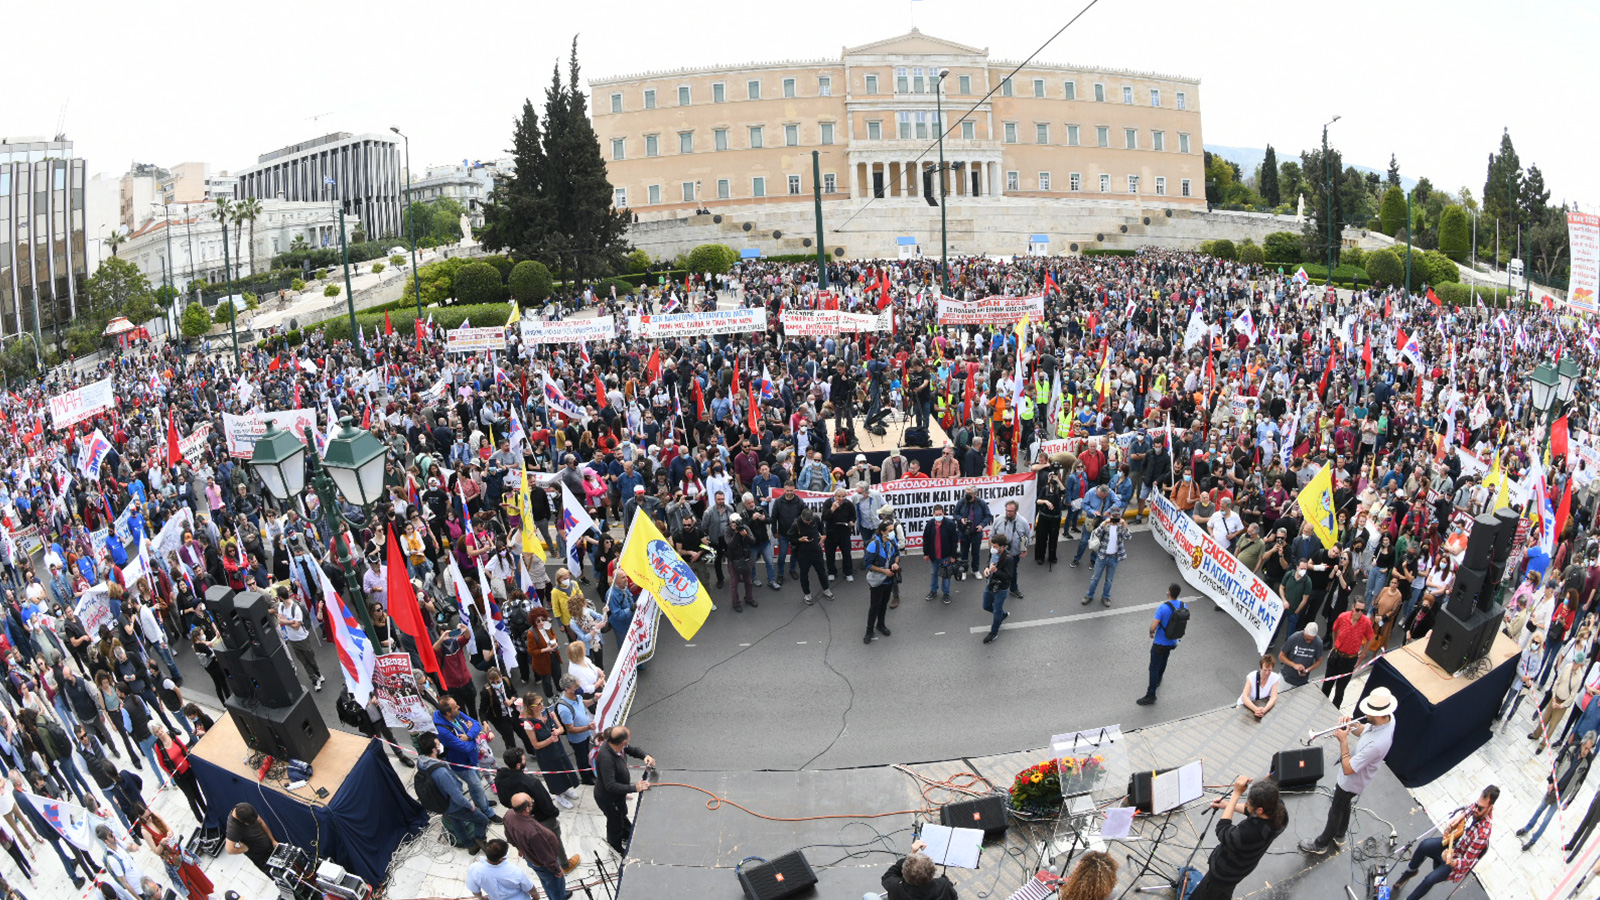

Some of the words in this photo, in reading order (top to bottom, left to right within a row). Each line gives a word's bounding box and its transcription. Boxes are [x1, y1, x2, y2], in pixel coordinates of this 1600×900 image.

[886, 479, 953, 490] ΟΙΚΟΔΟΜΩΝ
[956, 475, 1005, 486] ΕΛΛΑΔΑΣ
[882, 491, 930, 506] ΡΕΩΤΙΚΗ
[932, 490, 951, 503] ΚΑΙ
[978, 484, 1025, 500] ΠΕΚΤΑΘΕΙ
[893, 505, 934, 519] ΣΥΜΒΑΣ
[908, 520, 924, 533] ΜΕ
[651, 552, 690, 593] WFTU
[1201, 533, 1238, 575] ΤΣΑΚΙΖΕΙ
[1249, 577, 1269, 603] ΖΩΗ
[1202, 555, 1212, 572] Η
[1210, 563, 1256, 611] ΑΠΑΝΤΗΣΗ
[1257, 603, 1277, 632] ΜΑΣ
